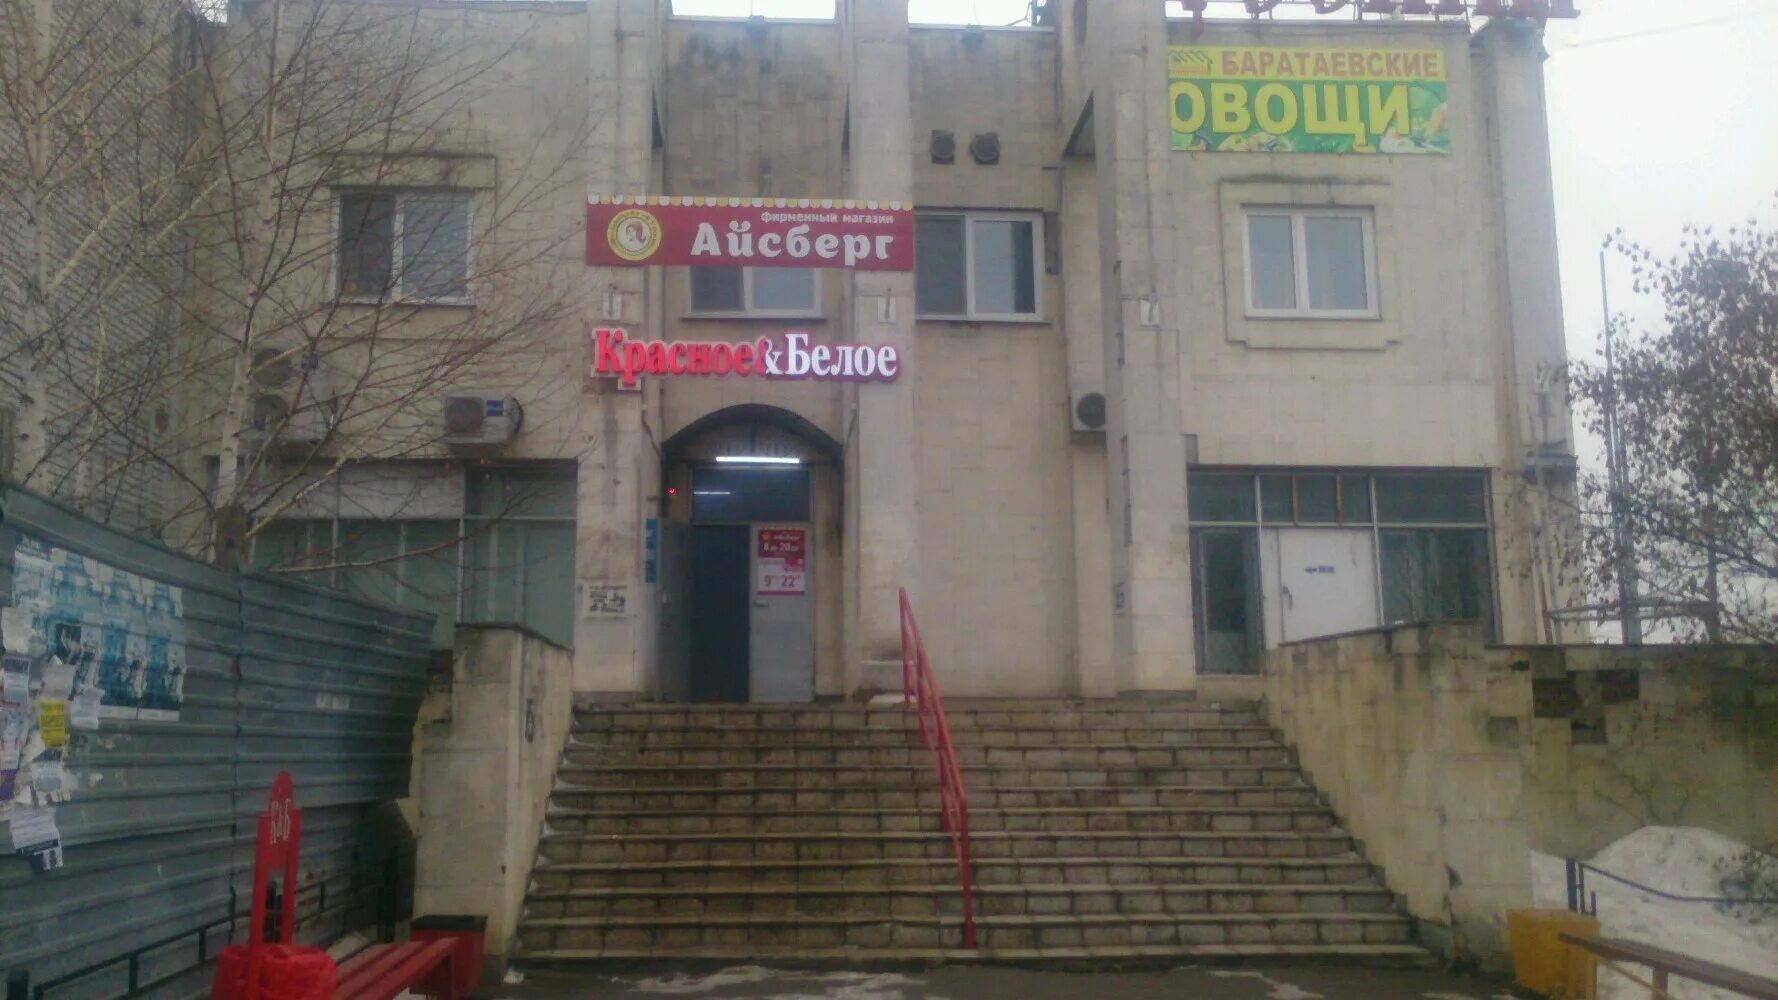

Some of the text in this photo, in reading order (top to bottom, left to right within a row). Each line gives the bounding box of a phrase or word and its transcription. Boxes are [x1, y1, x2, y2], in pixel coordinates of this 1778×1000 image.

[1221, 52, 1439, 77] БАРАТАЕВСКИЕ
[1168, 82, 1410, 147] ОВОЩИ
[843, 213, 894, 224] магазин
[690, 220, 894, 266] Айсберг
